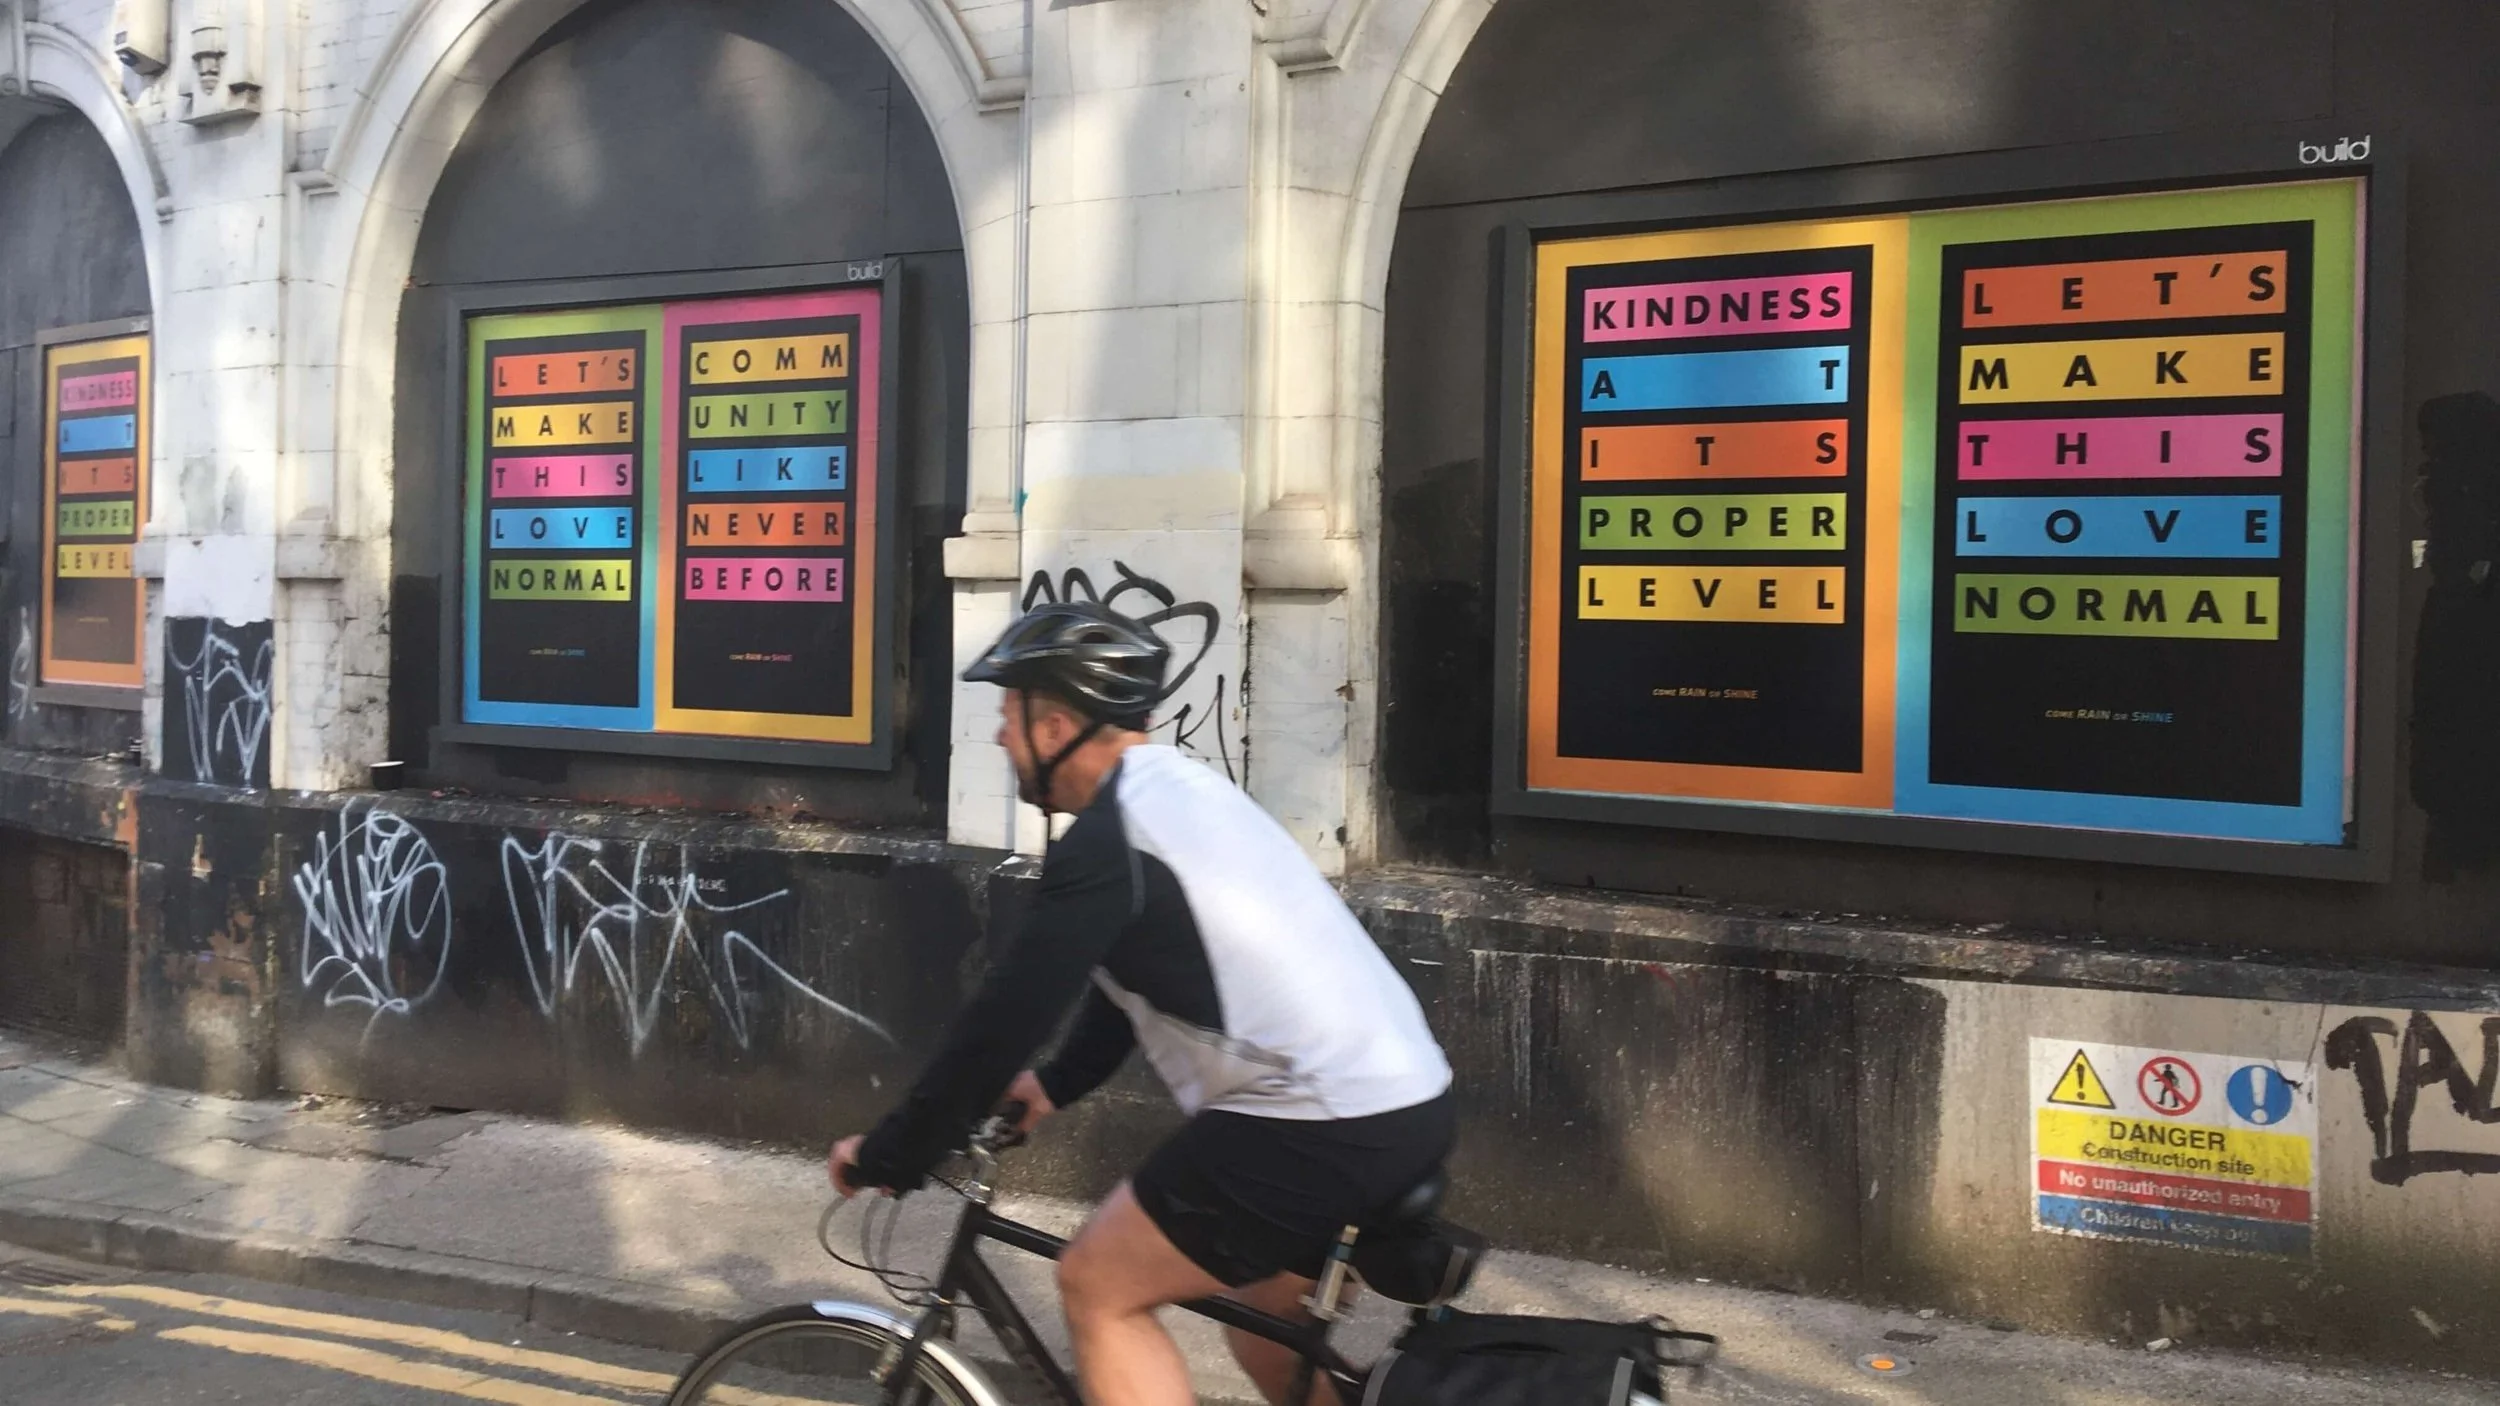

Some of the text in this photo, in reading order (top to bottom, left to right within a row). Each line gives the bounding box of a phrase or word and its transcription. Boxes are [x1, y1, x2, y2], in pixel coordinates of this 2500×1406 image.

[2299, 134, 2370, 164] build
[1972, 262, 2276, 315] LET'S
[1592, 285, 1841, 330] KINDNESS
[498, 355, 631, 388] LET'S
[695, 343, 844, 375] COMM
[1968, 347, 2273, 391] MAKE
[1590, 360, 1840, 400] AT
[497, 411, 629, 438] MAKE
[694, 400, 843, 430] UNITY
[1590, 431, 1838, 469] ITS
[1967, 427, 2273, 467] THIS
[496, 464, 628, 489] THIS
[694, 456, 841, 483] LIKE
[495, 516, 627, 540] LOVE
[692, 512, 840, 537] NEVER
[1588, 506, 1837, 538] PROPER
[1967, 508, 2269, 544] LOVE
[60, 551, 130, 570] LEVEL
[493, 568, 627, 592] NORMAL
[691, 567, 838, 592] BEFORE
[1588, 577, 1835, 610] LEVEL
[1964, 586, 2268, 627] NORMAL
[2077, 708, 2111, 720] RAIN
[2131, 711, 2174, 723] SHINE
[2109, 1121, 2226, 1151] DANGER
[2082, 1142, 2256, 1176] Construction site
[2059, 1168, 2087, 1187] No
[2092, 1176, 2223, 1204] unauthorized
